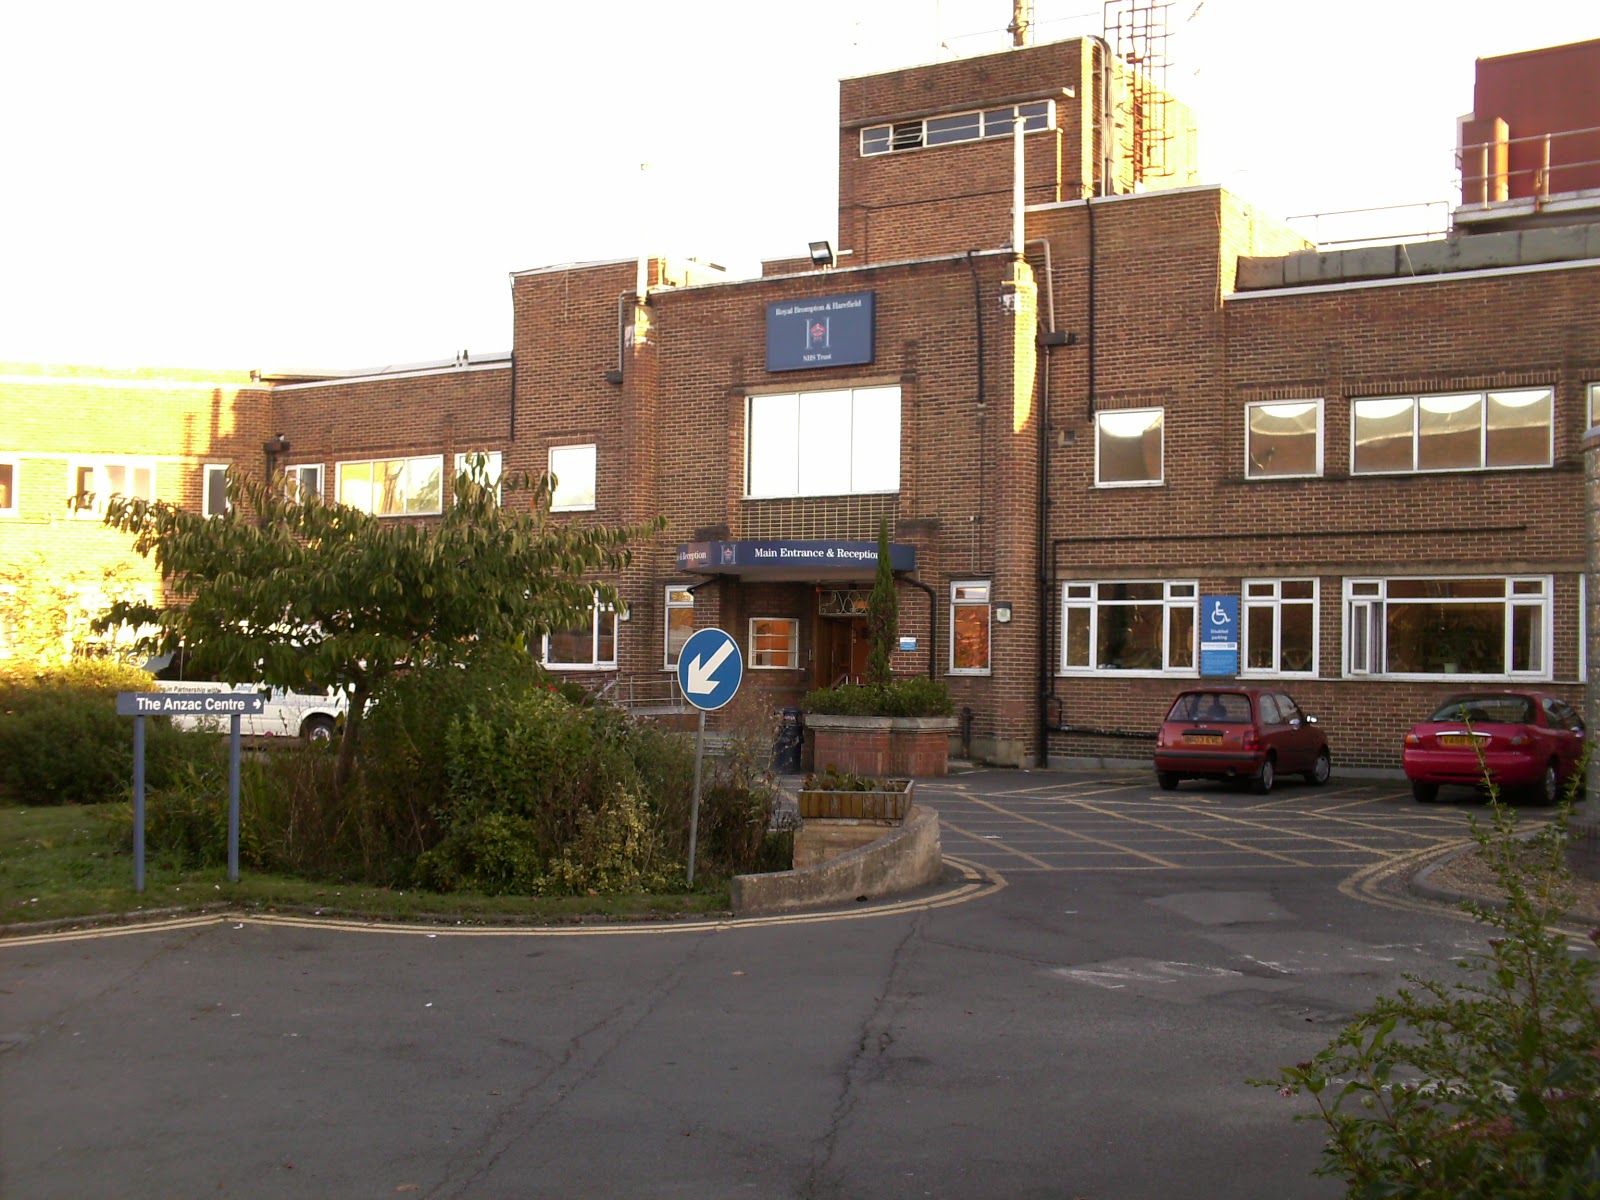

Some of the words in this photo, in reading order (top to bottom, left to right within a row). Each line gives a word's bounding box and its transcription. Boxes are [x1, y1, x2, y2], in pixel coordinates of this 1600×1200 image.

[775, 308, 793, 316] Royal
[794, 305, 825, 313] Brompton
[832, 300, 862, 310] Harefield
[754, 548, 778, 558] Main
[779, 548, 824, 558] Entrance
[826, 548, 835, 558] &
[173, 685, 206, 694] Partnership
[136, 697, 161, 711] The
[163, 697, 202, 711] Anzac
[205, 697, 246, 711] Centre
